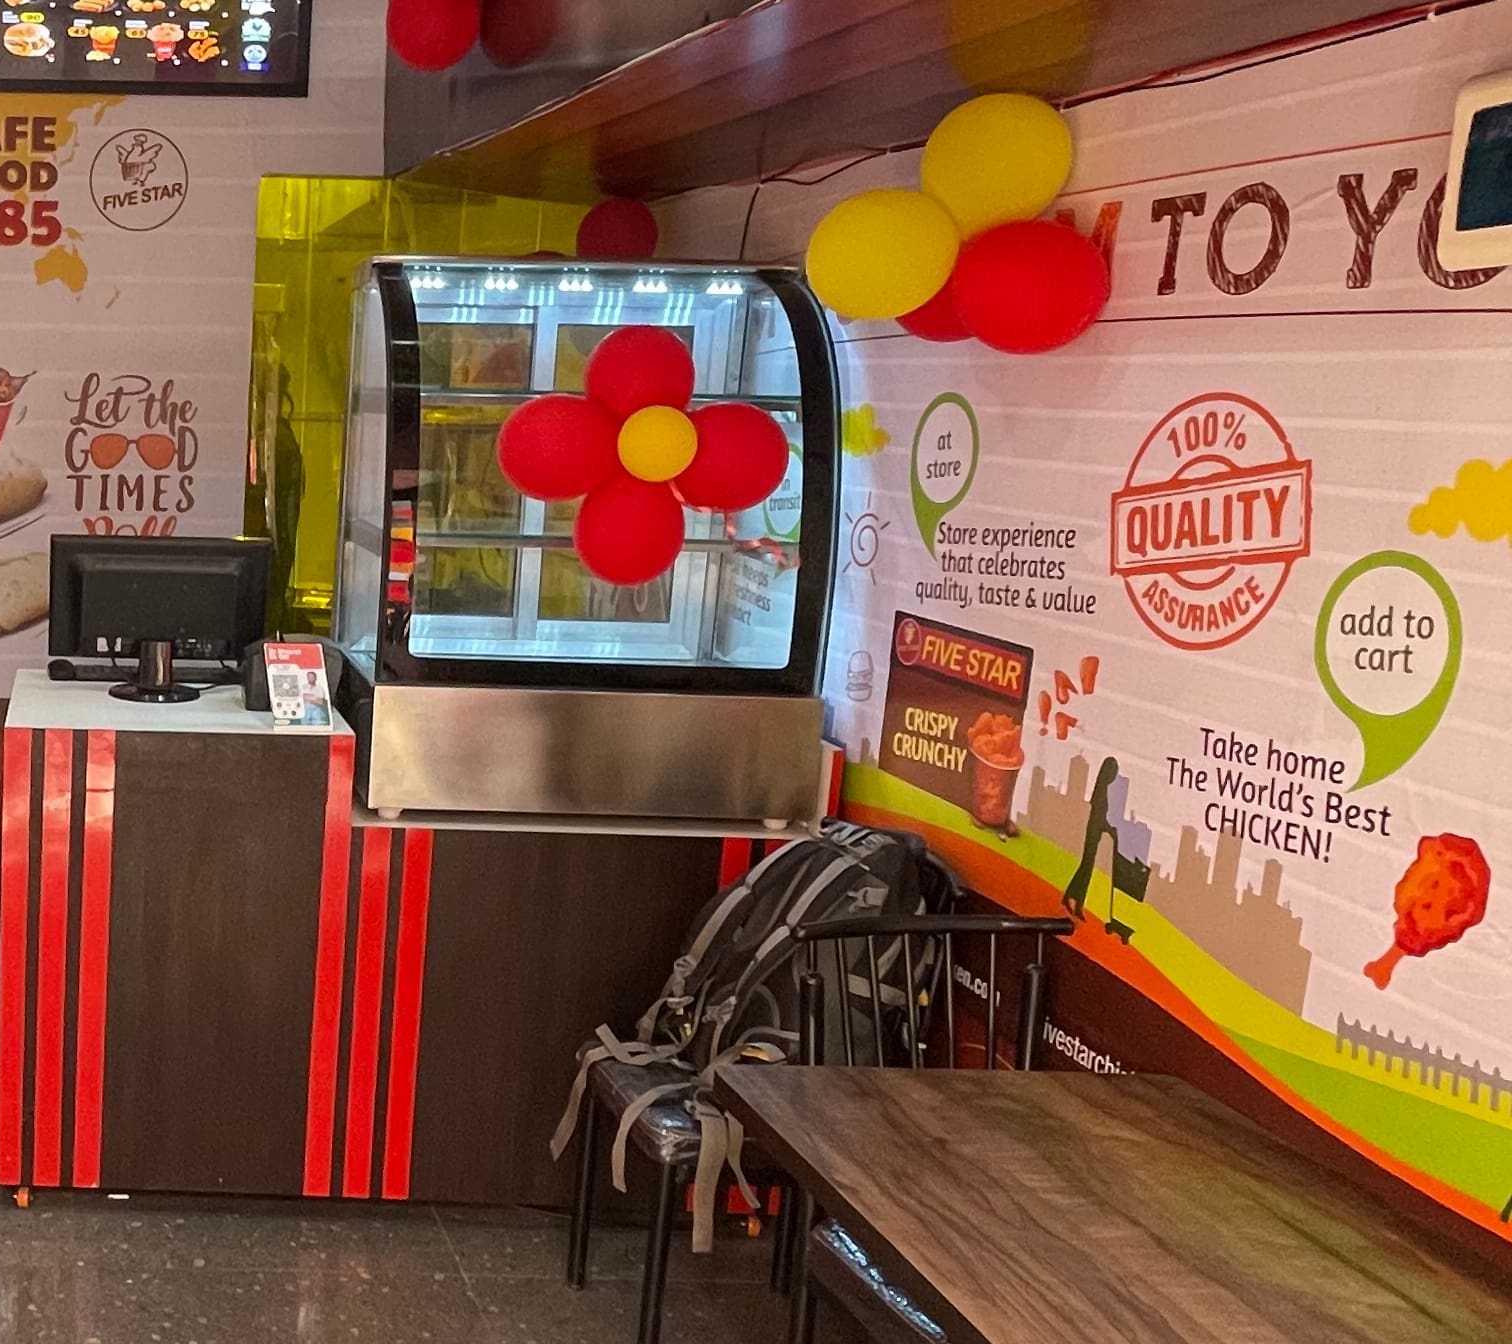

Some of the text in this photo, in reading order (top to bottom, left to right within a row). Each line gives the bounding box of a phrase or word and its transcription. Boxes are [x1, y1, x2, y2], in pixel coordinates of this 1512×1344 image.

[103, 182, 183, 210] FIVE STAR
[1151, 181, 1290, 296] TO
[64, 372, 198, 436] Let the
[937, 431, 952, 451] at
[1167, 411, 1246, 458] 100%
[926, 460, 961, 479] store
[66, 473, 195, 513] TIMES
[937, 521, 1077, 552] Store experience
[1126, 485, 1291, 557] QUALITY
[941, 549, 1066, 580] that celebrates
[916, 577, 1097, 614] quality, taste & value
[1142, 575, 1265, 632] ASSURANCE
[1340, 605, 1434, 639] add to
[922, 635, 1021, 691] FIVE STAR
[1355, 645, 1413, 674] cart
[905, 707, 959, 741] CRISPY
[892, 733, 968, 773] CRUNCHY
[1200, 727, 1346, 784] Take home
[1167, 757, 1392, 837] The World's Best
[1204, 803, 1333, 864] CHICKEN!
